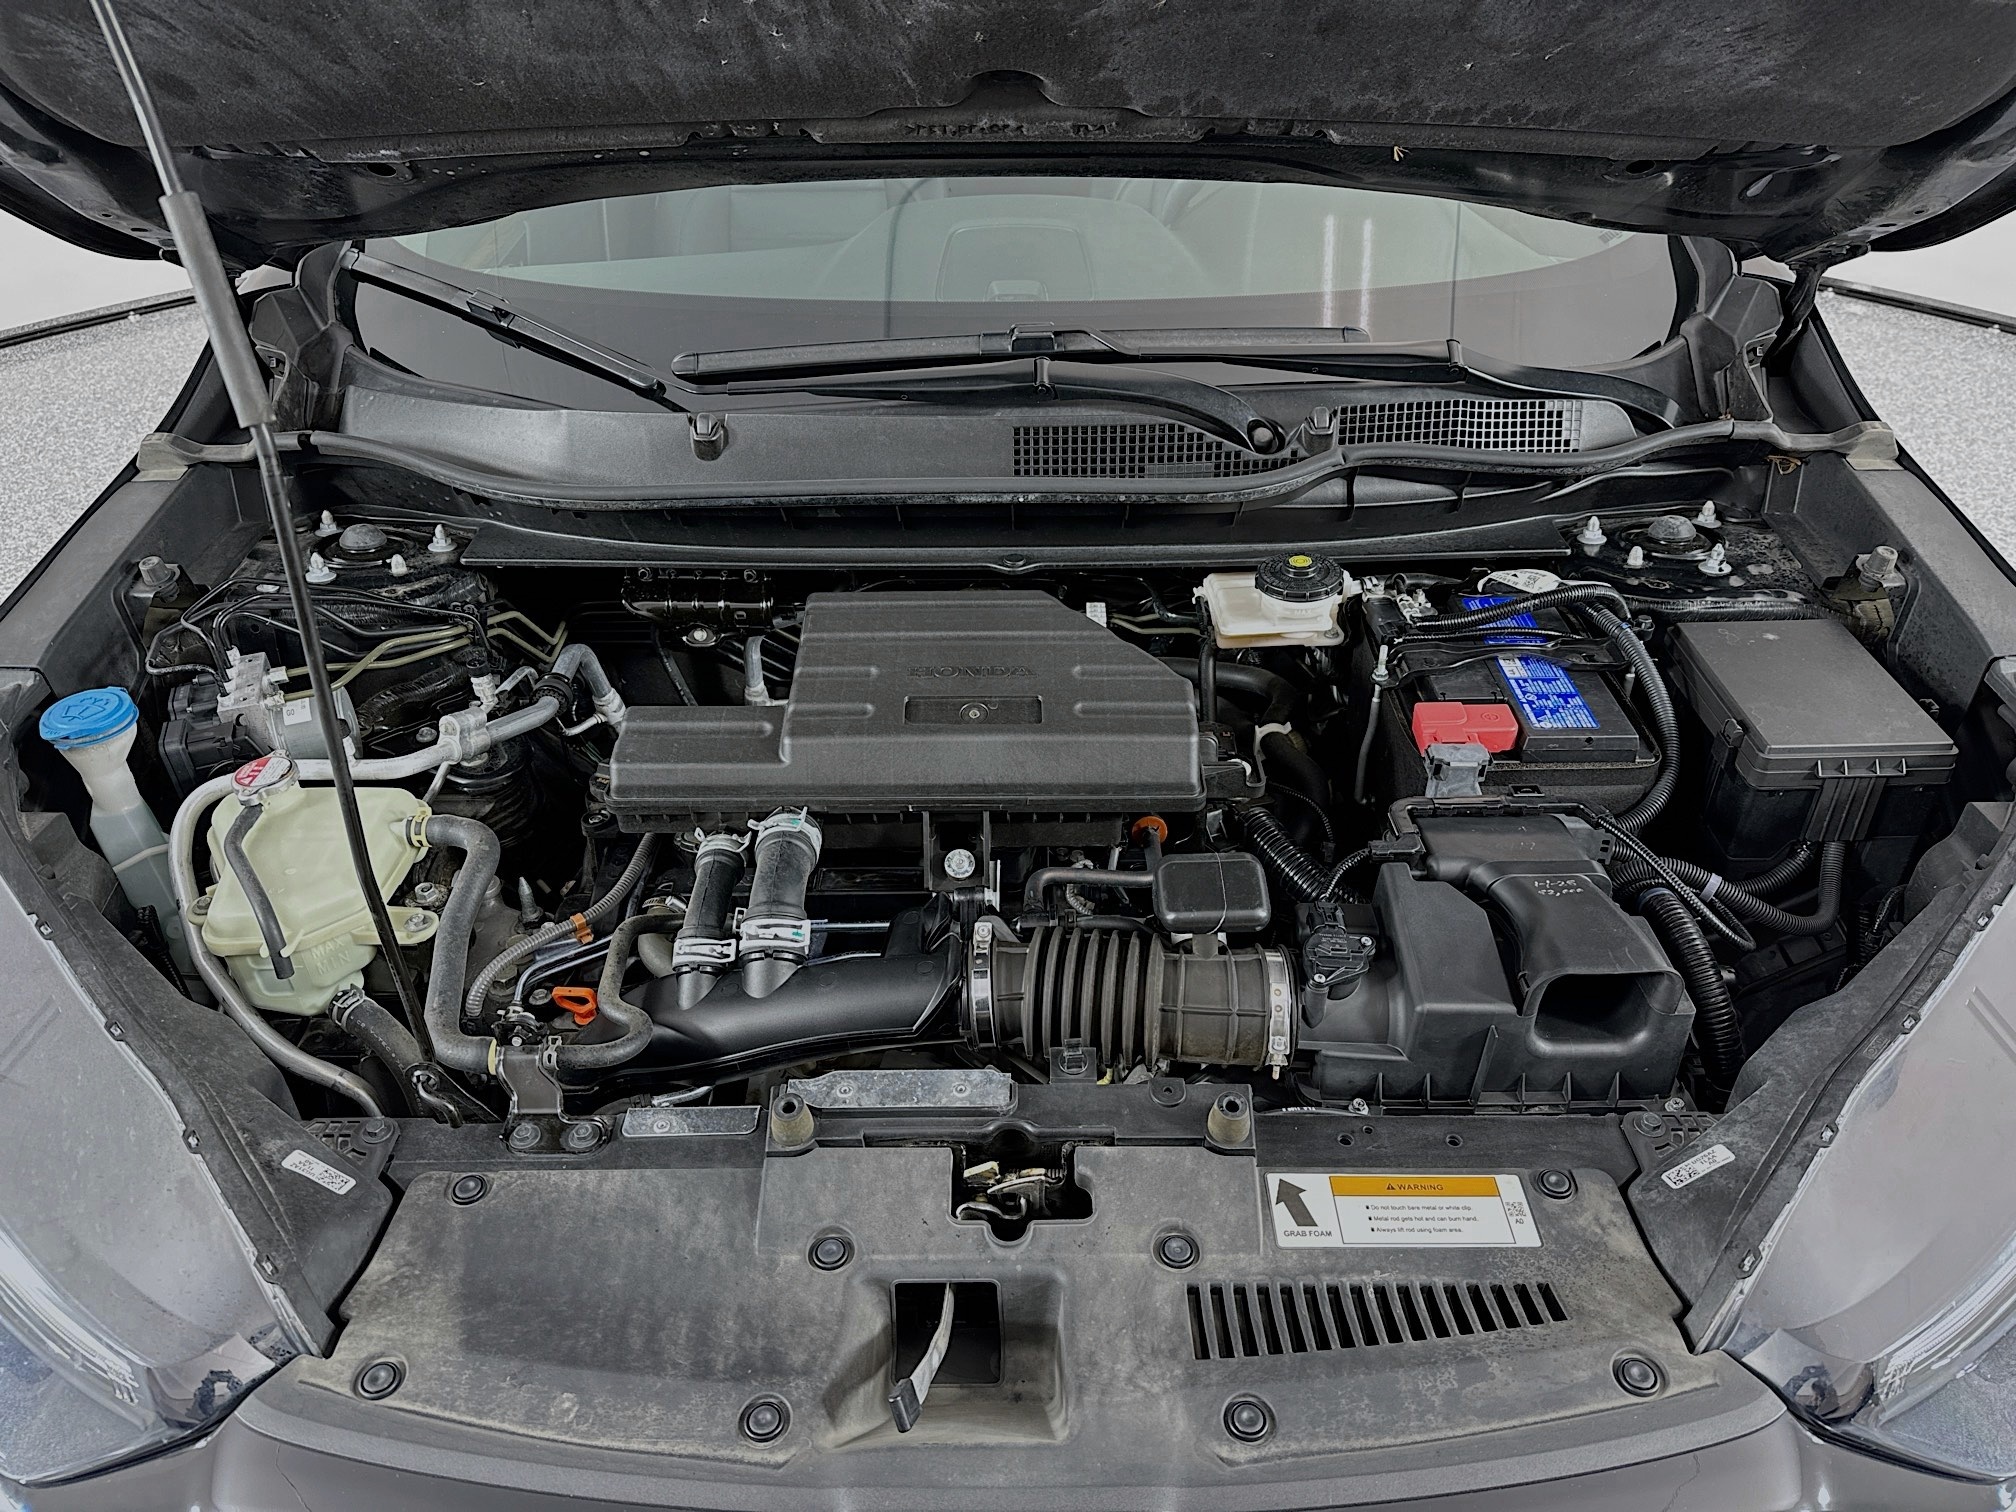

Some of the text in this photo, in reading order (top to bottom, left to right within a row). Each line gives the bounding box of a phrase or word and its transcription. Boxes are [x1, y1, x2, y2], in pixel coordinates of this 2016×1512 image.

[906, 665, 1039, 678] HONDA
[310, 937, 344, 959] MAX
[317, 950, 351, 975] MIN
[1397, 1183, 1444, 1191] WARNING
